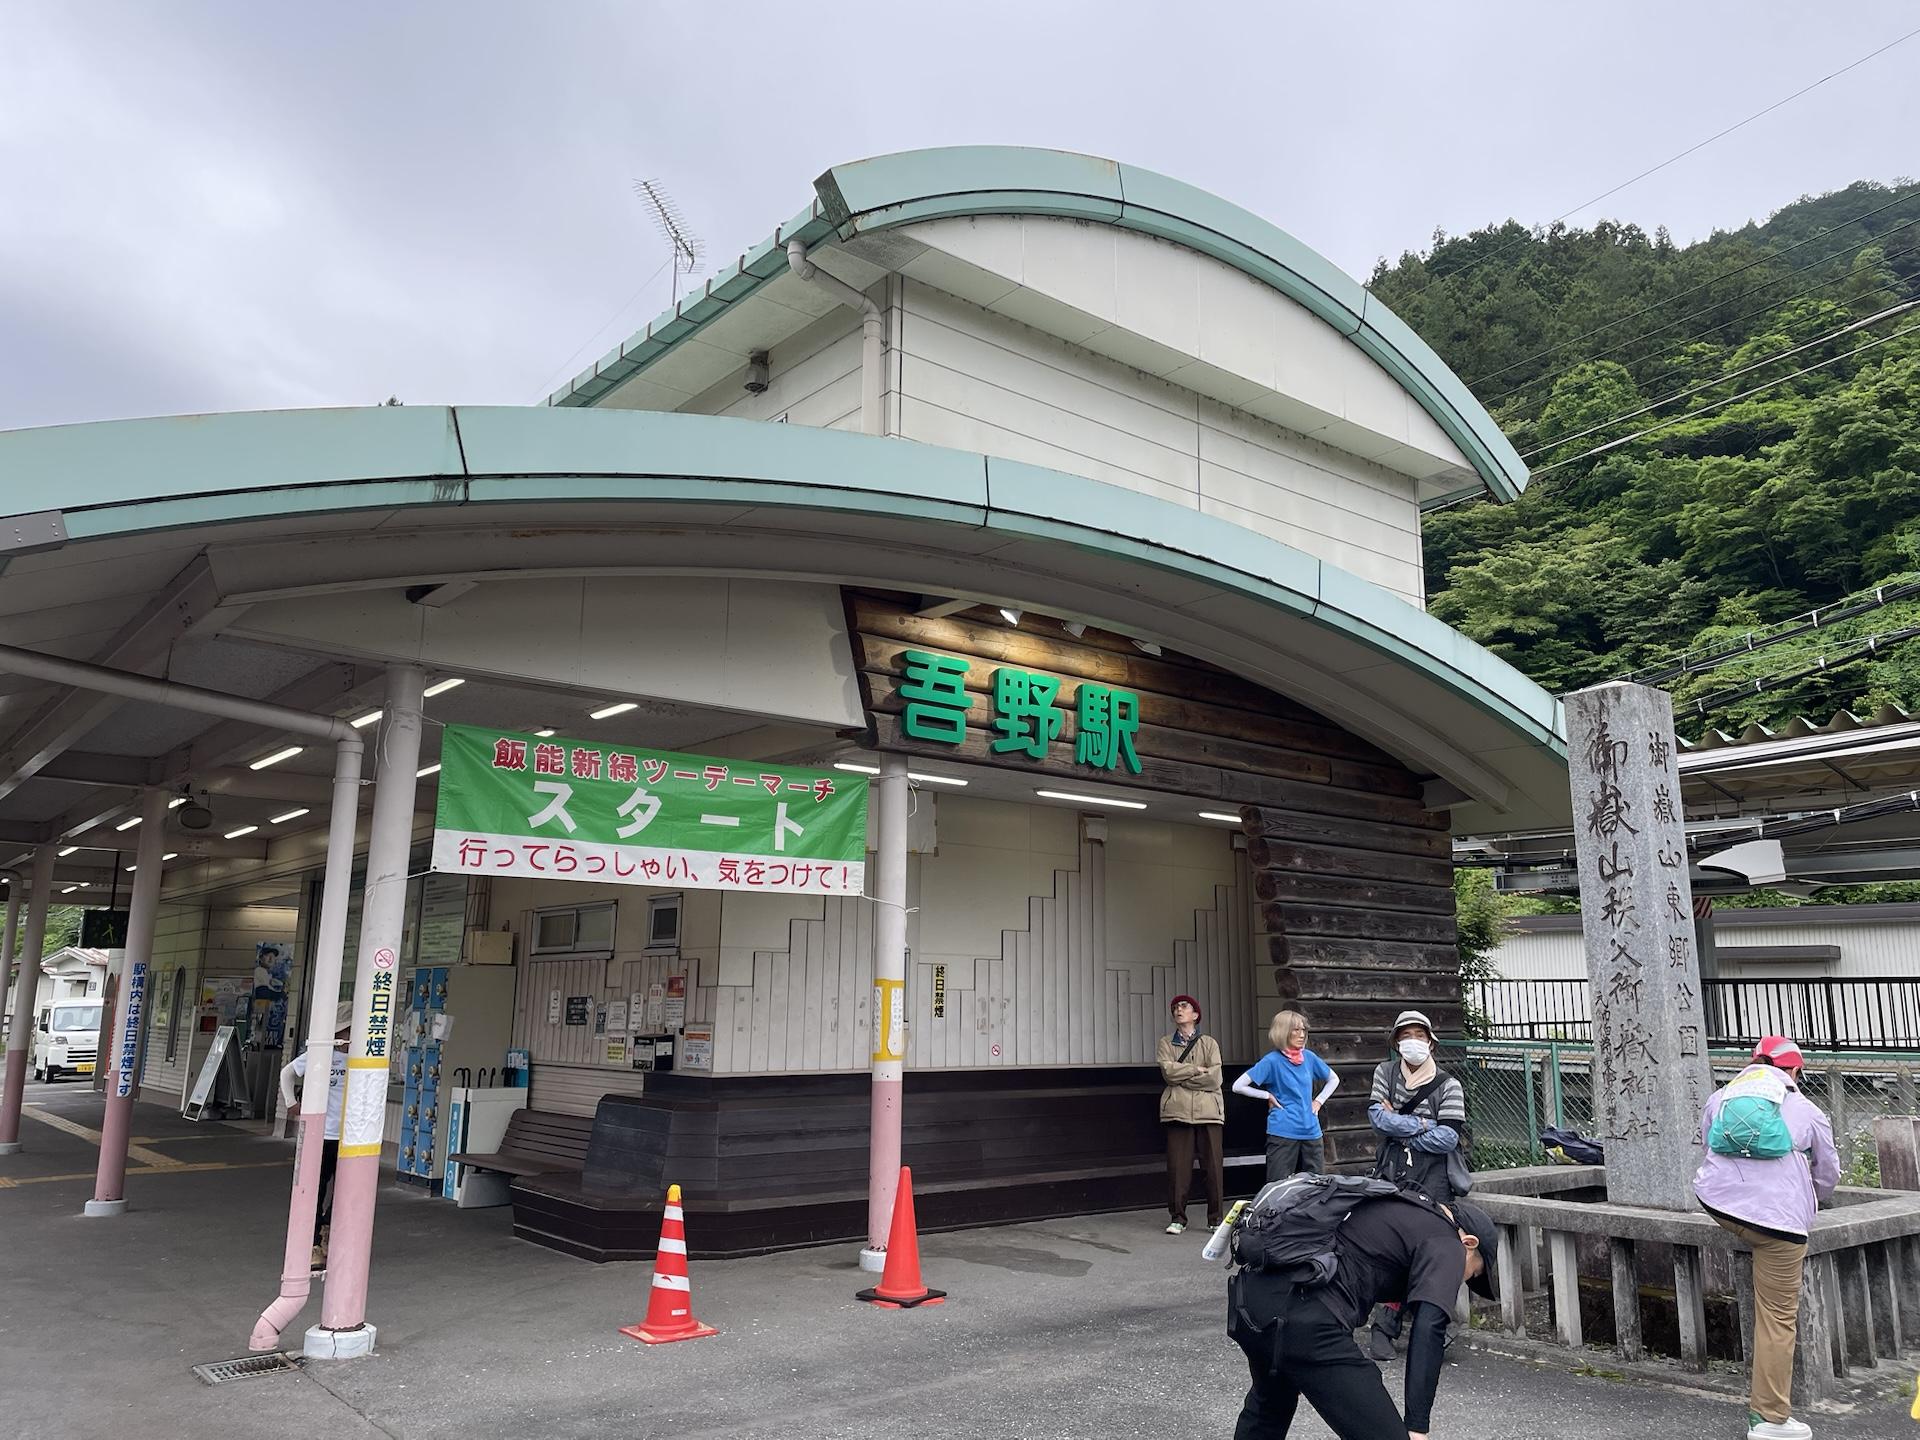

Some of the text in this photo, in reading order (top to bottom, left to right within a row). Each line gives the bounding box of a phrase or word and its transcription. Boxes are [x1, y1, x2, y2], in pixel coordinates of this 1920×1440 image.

[898, 648, 1143, 775] 吾野駅
[492, 738, 836, 804] 飯能新緑ツーデーマーチ
[527, 779, 805, 852] スタート
[457, 837, 849, 890] 行ってらっしゃい、気をつけて！
[1581, 720, 1661, 1138] 御嶽山秩父御嶽神社
[118, 962, 147, 1097] 駅構内は終日禁煙です
[365, 970, 394, 1058] 終日禁煙
[933, 965, 946, 1019] 終日禁煙
